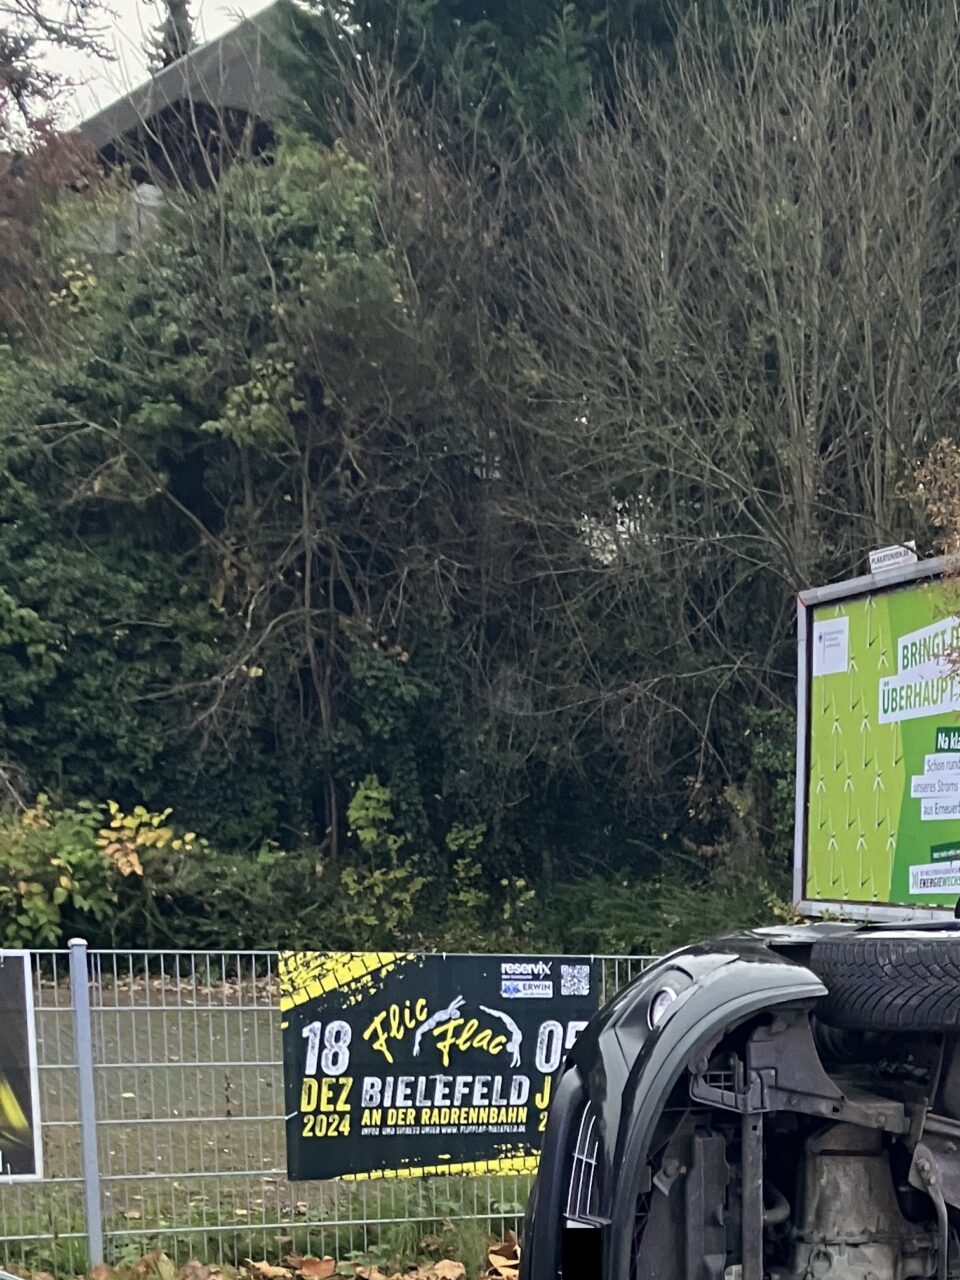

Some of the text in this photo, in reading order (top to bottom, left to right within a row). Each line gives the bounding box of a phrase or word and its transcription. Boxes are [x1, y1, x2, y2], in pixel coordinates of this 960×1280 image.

[903, 629, 947, 671] BRINGT
[882, 675, 955, 714] ÜBERHAUPT
[938, 733, 948, 749] Na
[927, 760, 945, 772] Schon
[946, 758, 960, 770] rund
[913, 783, 936, 793] unseres
[938, 780, 958, 792] Stroms
[923, 806, 933, 815] aus
[501, 961, 552, 979] reservix
[523, 983, 550, 991] ERWIN
[362, 998, 428, 1063] Flic
[432, 1018, 508, 1067] Flac
[302, 1021, 352, 1075] 18
[301, 1077, 353, 1112] DEZ
[361, 1075, 530, 1107] BIELEFELD
[302, 1113, 351, 1137] 2024
[361, 1109, 382, 1126] AN
[387, 1108, 416, 1125] DER
[421, 1107, 528, 1125] RADRENNBAHN
